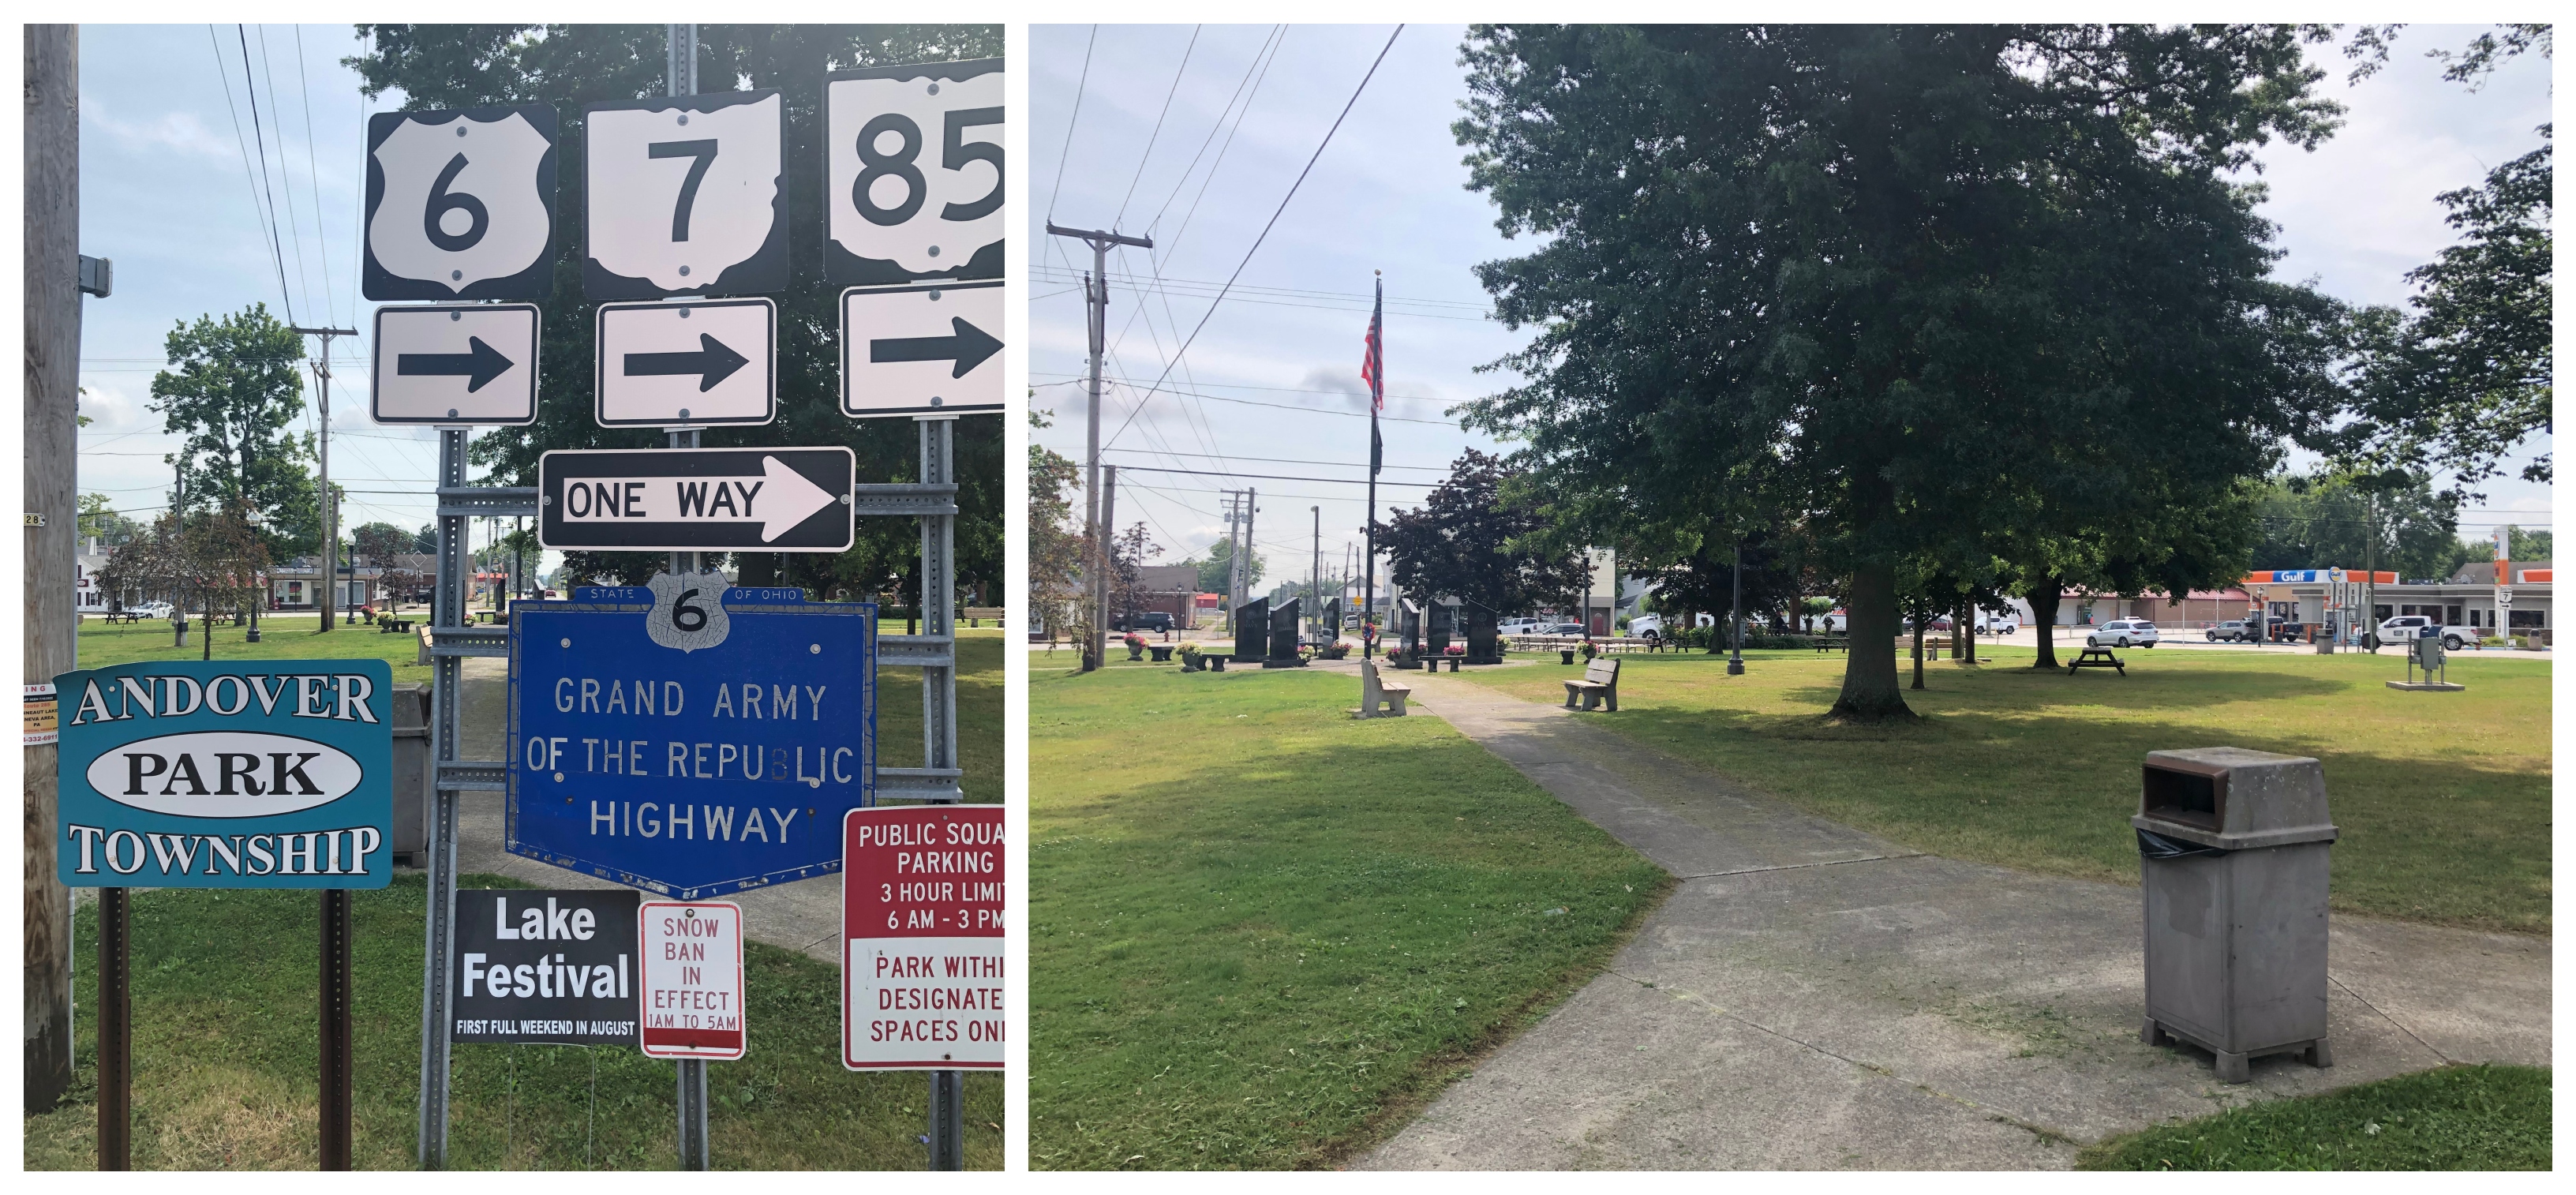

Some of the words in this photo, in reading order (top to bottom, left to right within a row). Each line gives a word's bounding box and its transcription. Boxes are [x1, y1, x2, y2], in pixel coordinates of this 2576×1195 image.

[852, 106, 1005, 227] 85
[424, 152, 489, 252] 6
[648, 138, 718, 242] 7
[567, 482, 646, 518] ONE
[677, 481, 764, 518] WAY
[2281, 571, 2305, 582] Gulf
[590, 589, 634, 598] STATE
[735, 590, 751, 599] OF
[762, 590, 796, 600] OHIO
[672, 588, 707, 631] 6
[70, 673, 380, 727] ANDOVER
[555, 677, 684, 716] GRAND
[713, 683, 827, 721] ARMY
[526, 736, 568, 771] OF
[582, 738, 648, 776] THE
[668, 741, 854, 785] REPUBLIC
[122, 752, 325, 796] PARK
[590, 800, 799, 844] HIGHWAY
[859, 823, 936, 848] PUBLIC
[946, 822, 1005, 845] SQUA
[68, 823, 382, 876] TOWNSHIP
[897, 852, 994, 874] PARKING
[881, 882, 891, 902] 3
[899, 882, 953, 902] HOUR
[962, 882, 1005, 901] LIMI
[496, 897, 595, 940] Lake
[664, 918, 719, 938] SNOW
[888, 910, 899, 930] 6
[908, 909, 934, 929] AM
[958, 909, 969, 929] 3
[979, 909, 1005, 929] PM
[665, 942, 705, 961] BAN
[463, 953, 629, 999] Festival
[683, 966, 701, 985] IN
[876, 957, 934, 980] PARK
[655, 991, 729, 1011] EFFECT
[879, 987, 1003, 1010] DESIGNATE
[457, 1020, 488, 1035] FIRST
[491, 1020, 518, 1035] FULL
[520, 1020, 572, 1035] WEEKEND
[576, 1020, 587, 1035] IN
[590, 1021, 635, 1036] AUGUST
[649, 1013, 674, 1028] 1AM
[683, 1015, 699, 1028] TO
[708, 1016, 736, 1031] 5AM
[871, 1020, 958, 1043] SPACES
